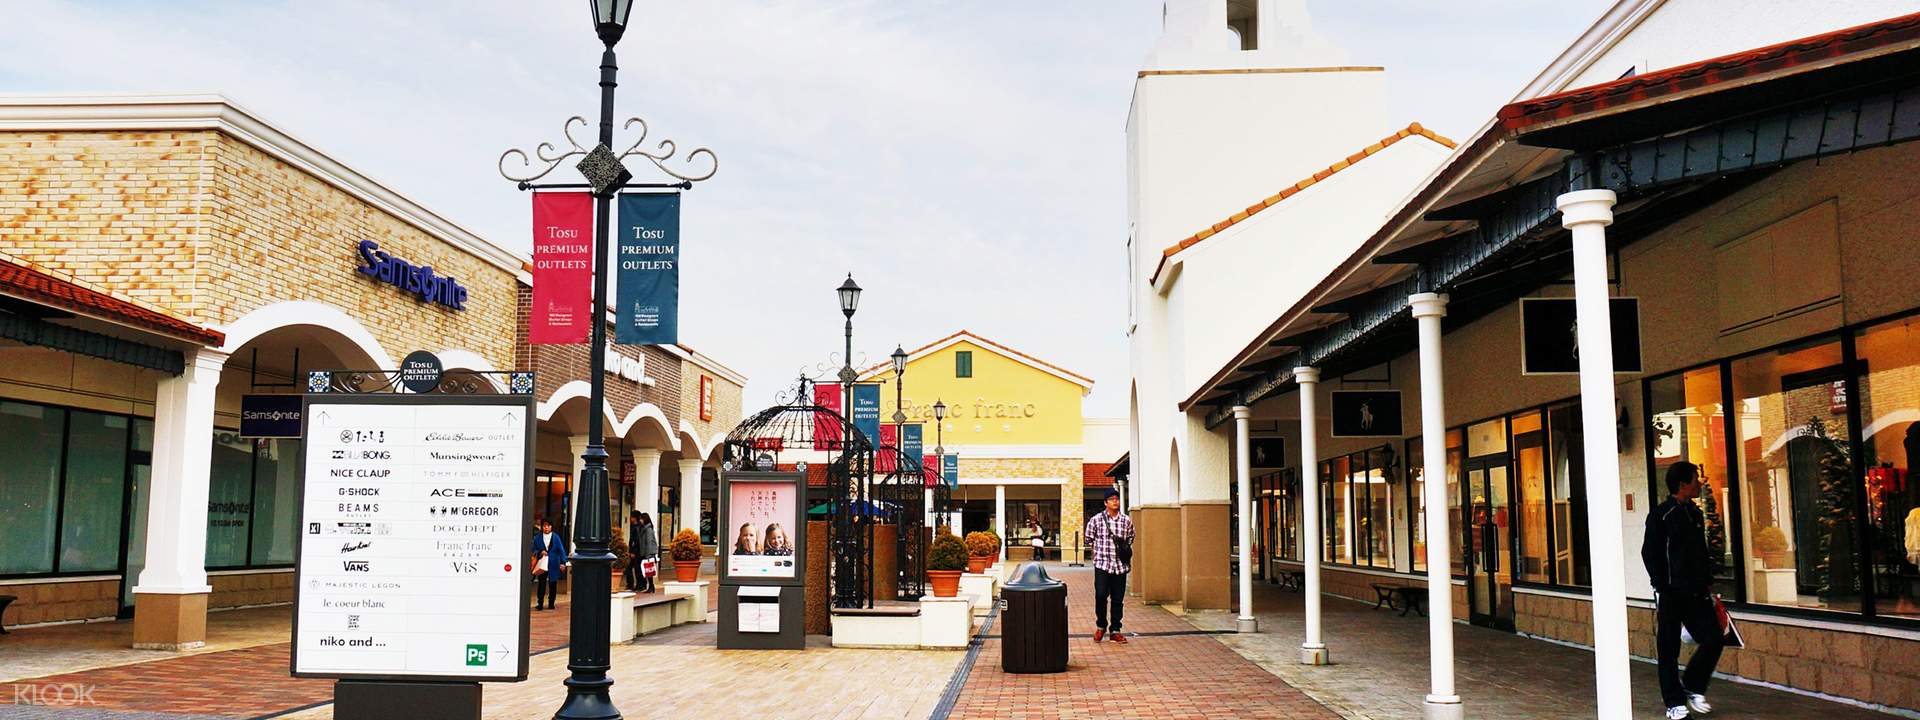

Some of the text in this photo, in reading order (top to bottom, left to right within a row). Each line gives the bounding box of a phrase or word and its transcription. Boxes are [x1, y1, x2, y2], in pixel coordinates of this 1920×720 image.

[536, 245, 588, 255] PREMIUM
[621, 245, 674, 255] PREMIUM
[537, 260, 587, 269] OUTLETS
[622, 260, 673, 270] OUTLETS
[358, 239, 467, 312] Samsonite
[243, 410, 300, 421] Samsonite
[330, 469, 391, 478] NICE CLAUP
[430, 488, 465, 497] ACE
[338, 503, 379, 512] BEAMS
[343, 561, 369, 572] VANS
[323, 598, 332, 608] le
[320, 637, 346, 647] niko
[349, 637, 373, 647] and
[467, 648, 486, 661] P5
